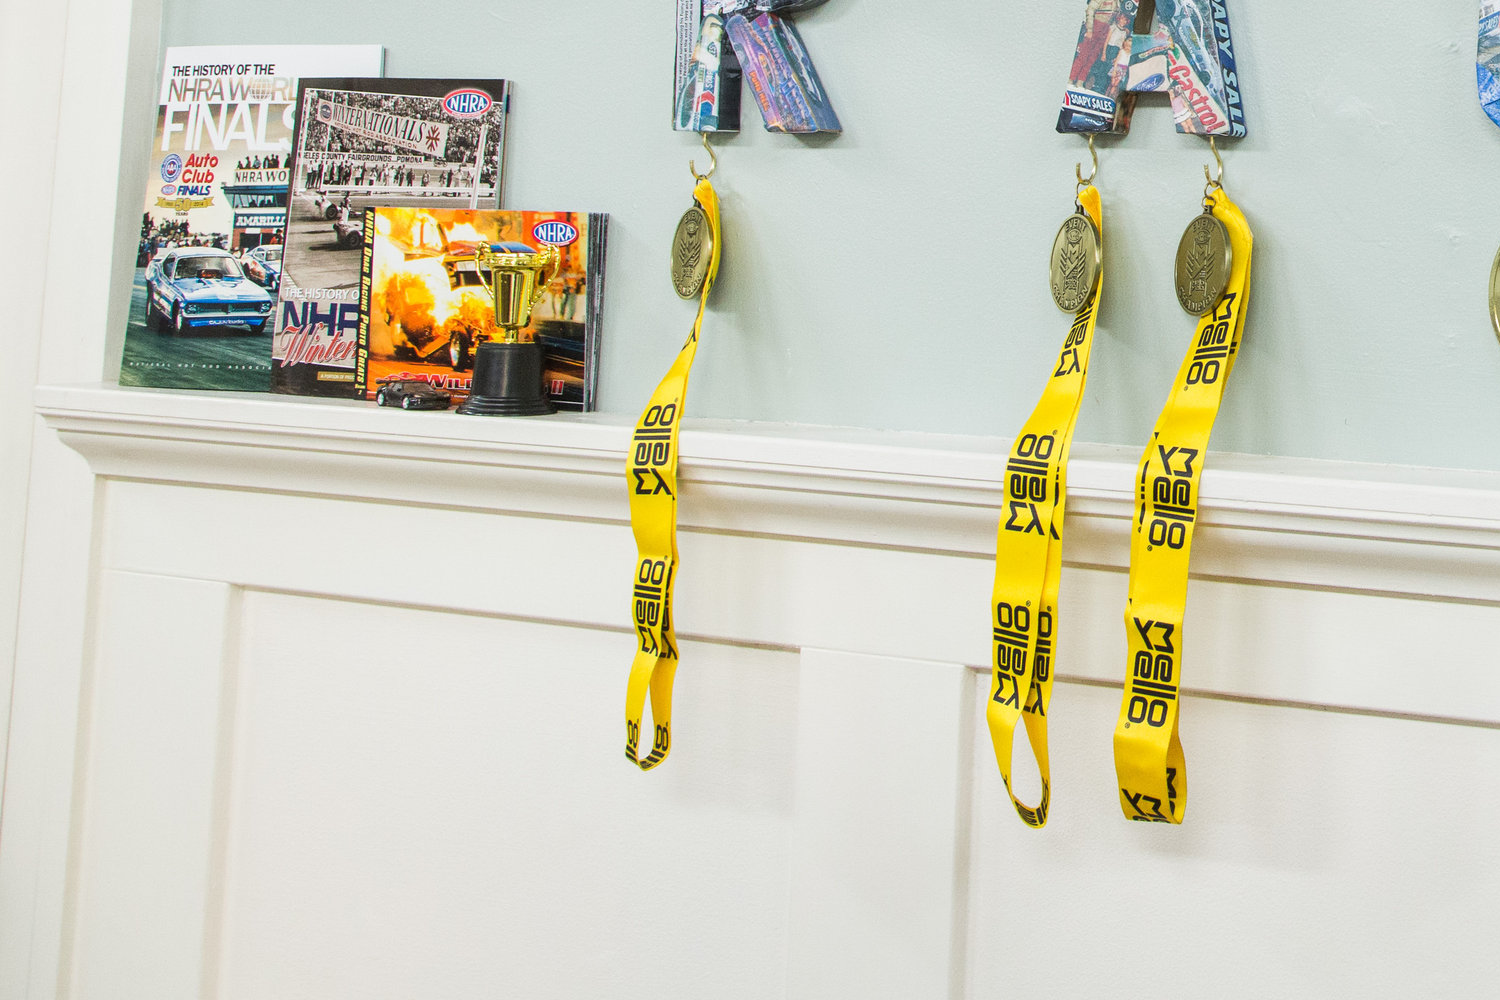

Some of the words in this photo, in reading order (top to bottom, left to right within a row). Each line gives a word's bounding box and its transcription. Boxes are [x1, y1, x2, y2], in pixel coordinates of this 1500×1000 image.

[172, 65, 191, 77] THE
[192, 64, 235, 76] HISTORY
[236, 64, 251, 76] OF
[253, 63, 275, 75] THE
[168, 78, 225, 102] NHRA
[1168, 64, 1227, 134] Castrol
[450, 95, 487, 113] NHRA
[1070, 93, 1092, 109] SOAPY
[1091, 97, 1113, 113] SALES
[332, 103, 428, 144] WINTERNATIONALS
[184, 153, 219, 168] Auto
[181, 168, 215, 184] Club
[235, 171, 263, 183] NHRA
[265, 170, 288, 182] WO
[176, 184, 211, 196] FINALS
[363, 210, 375, 244] NHRA
[538, 223, 573, 242] NHRA
[285, 287, 303, 298] THE
[304, 288, 350, 300] HISTORY
